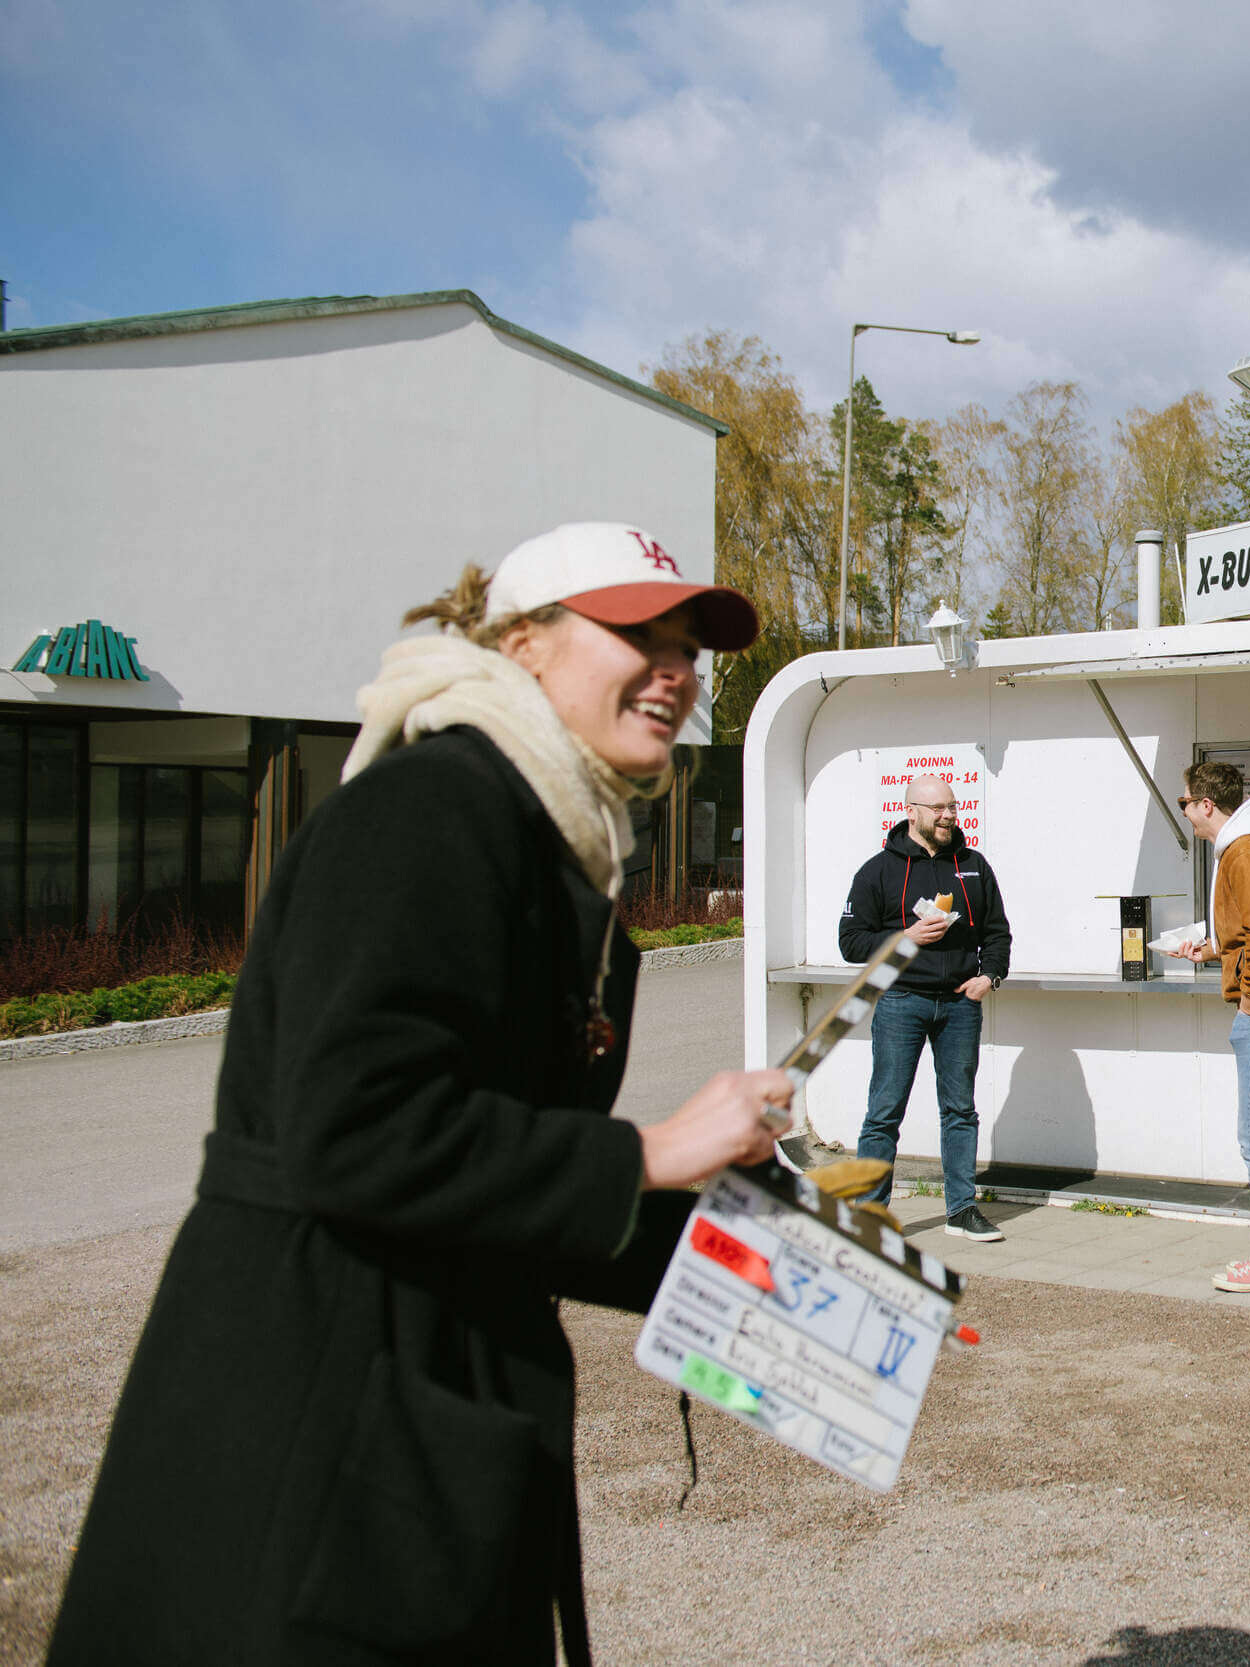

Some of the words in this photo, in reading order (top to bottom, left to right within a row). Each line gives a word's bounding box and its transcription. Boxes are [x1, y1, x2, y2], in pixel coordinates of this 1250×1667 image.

[626, 530, 683, 578] LA
[45, 619, 151, 681] BLANC
[881, 775, 914, 785] MA-PE
[963, 772, 978, 783] 14
[906, 757, 954, 768] AVOINNA
[777, 1267, 839, 1320] 37
